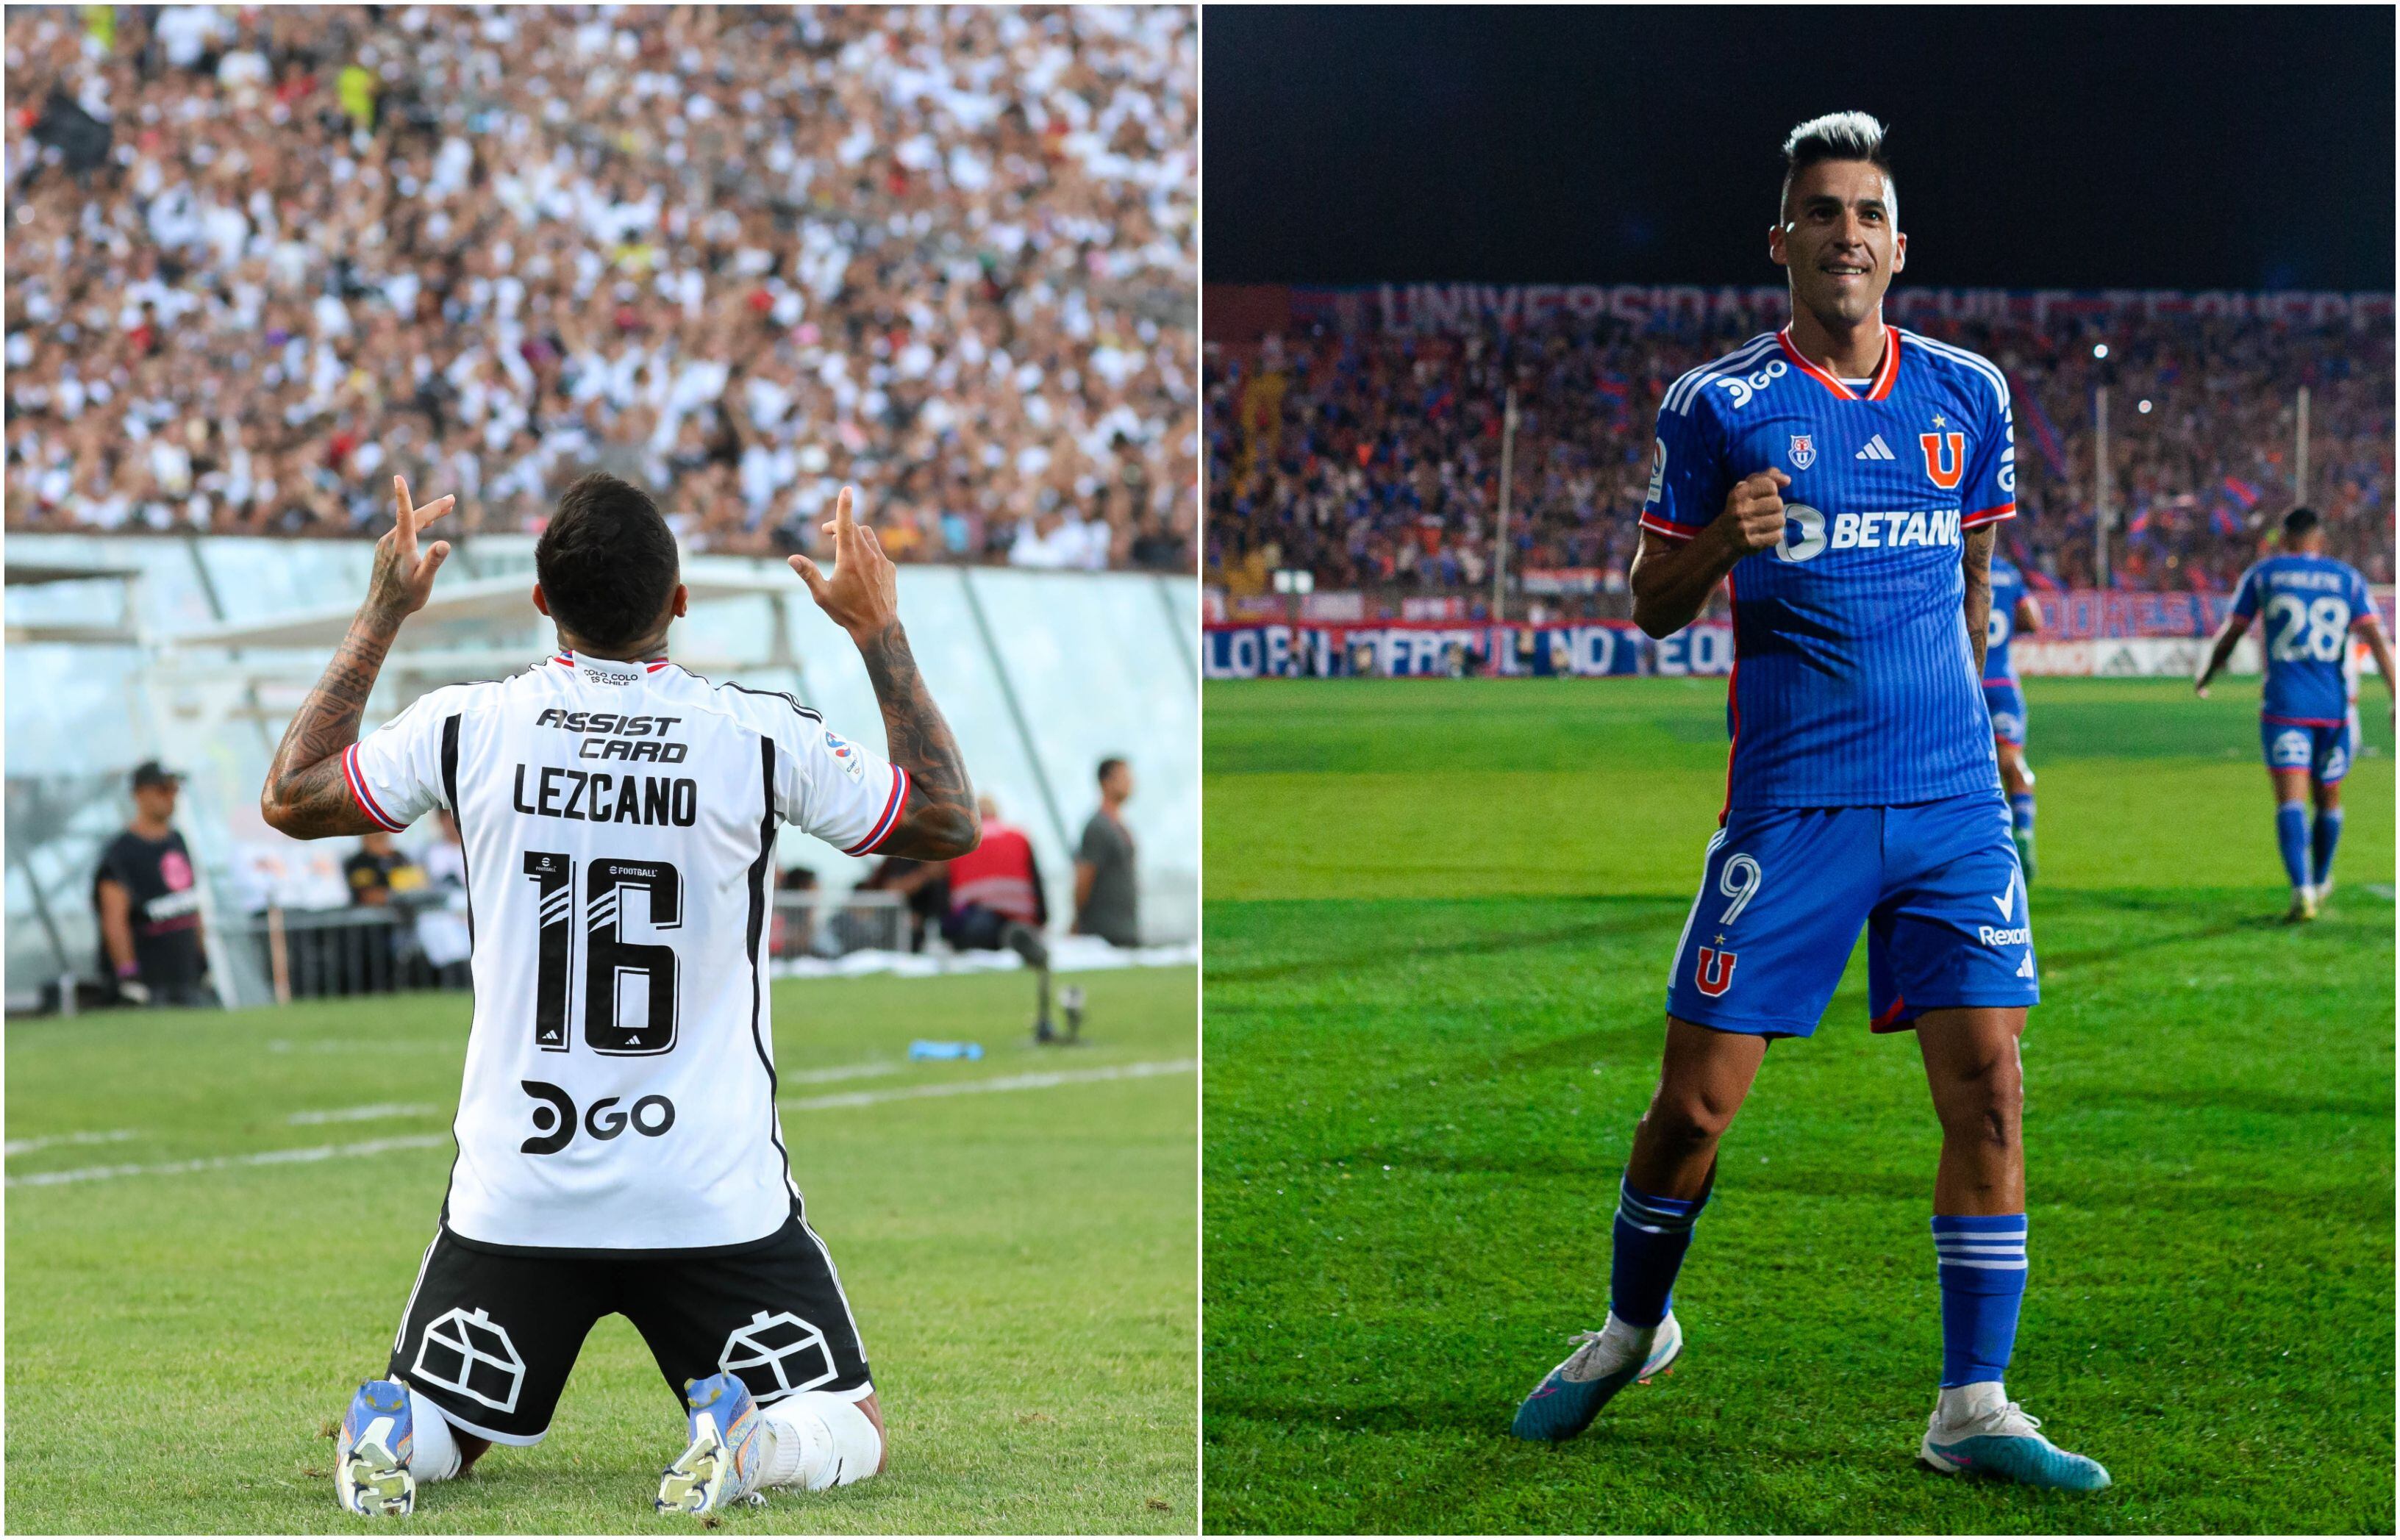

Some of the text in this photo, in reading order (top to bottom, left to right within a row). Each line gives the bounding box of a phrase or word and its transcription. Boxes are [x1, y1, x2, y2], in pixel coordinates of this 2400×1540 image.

[1919, 431, 1965, 489] U
[2266, 592, 2351, 662] 28
[584, 669, 638, 681] COLO COLO
[602, 678, 630, 686] CHILE
[536, 708, 682, 737] ASSIST
[579, 738, 688, 764] CARD
[513, 763, 697, 827] LEZCANO
[1719, 853, 1762, 925] 9
[523, 850, 683, 1057] 16
[1694, 945, 1738, 998] U
